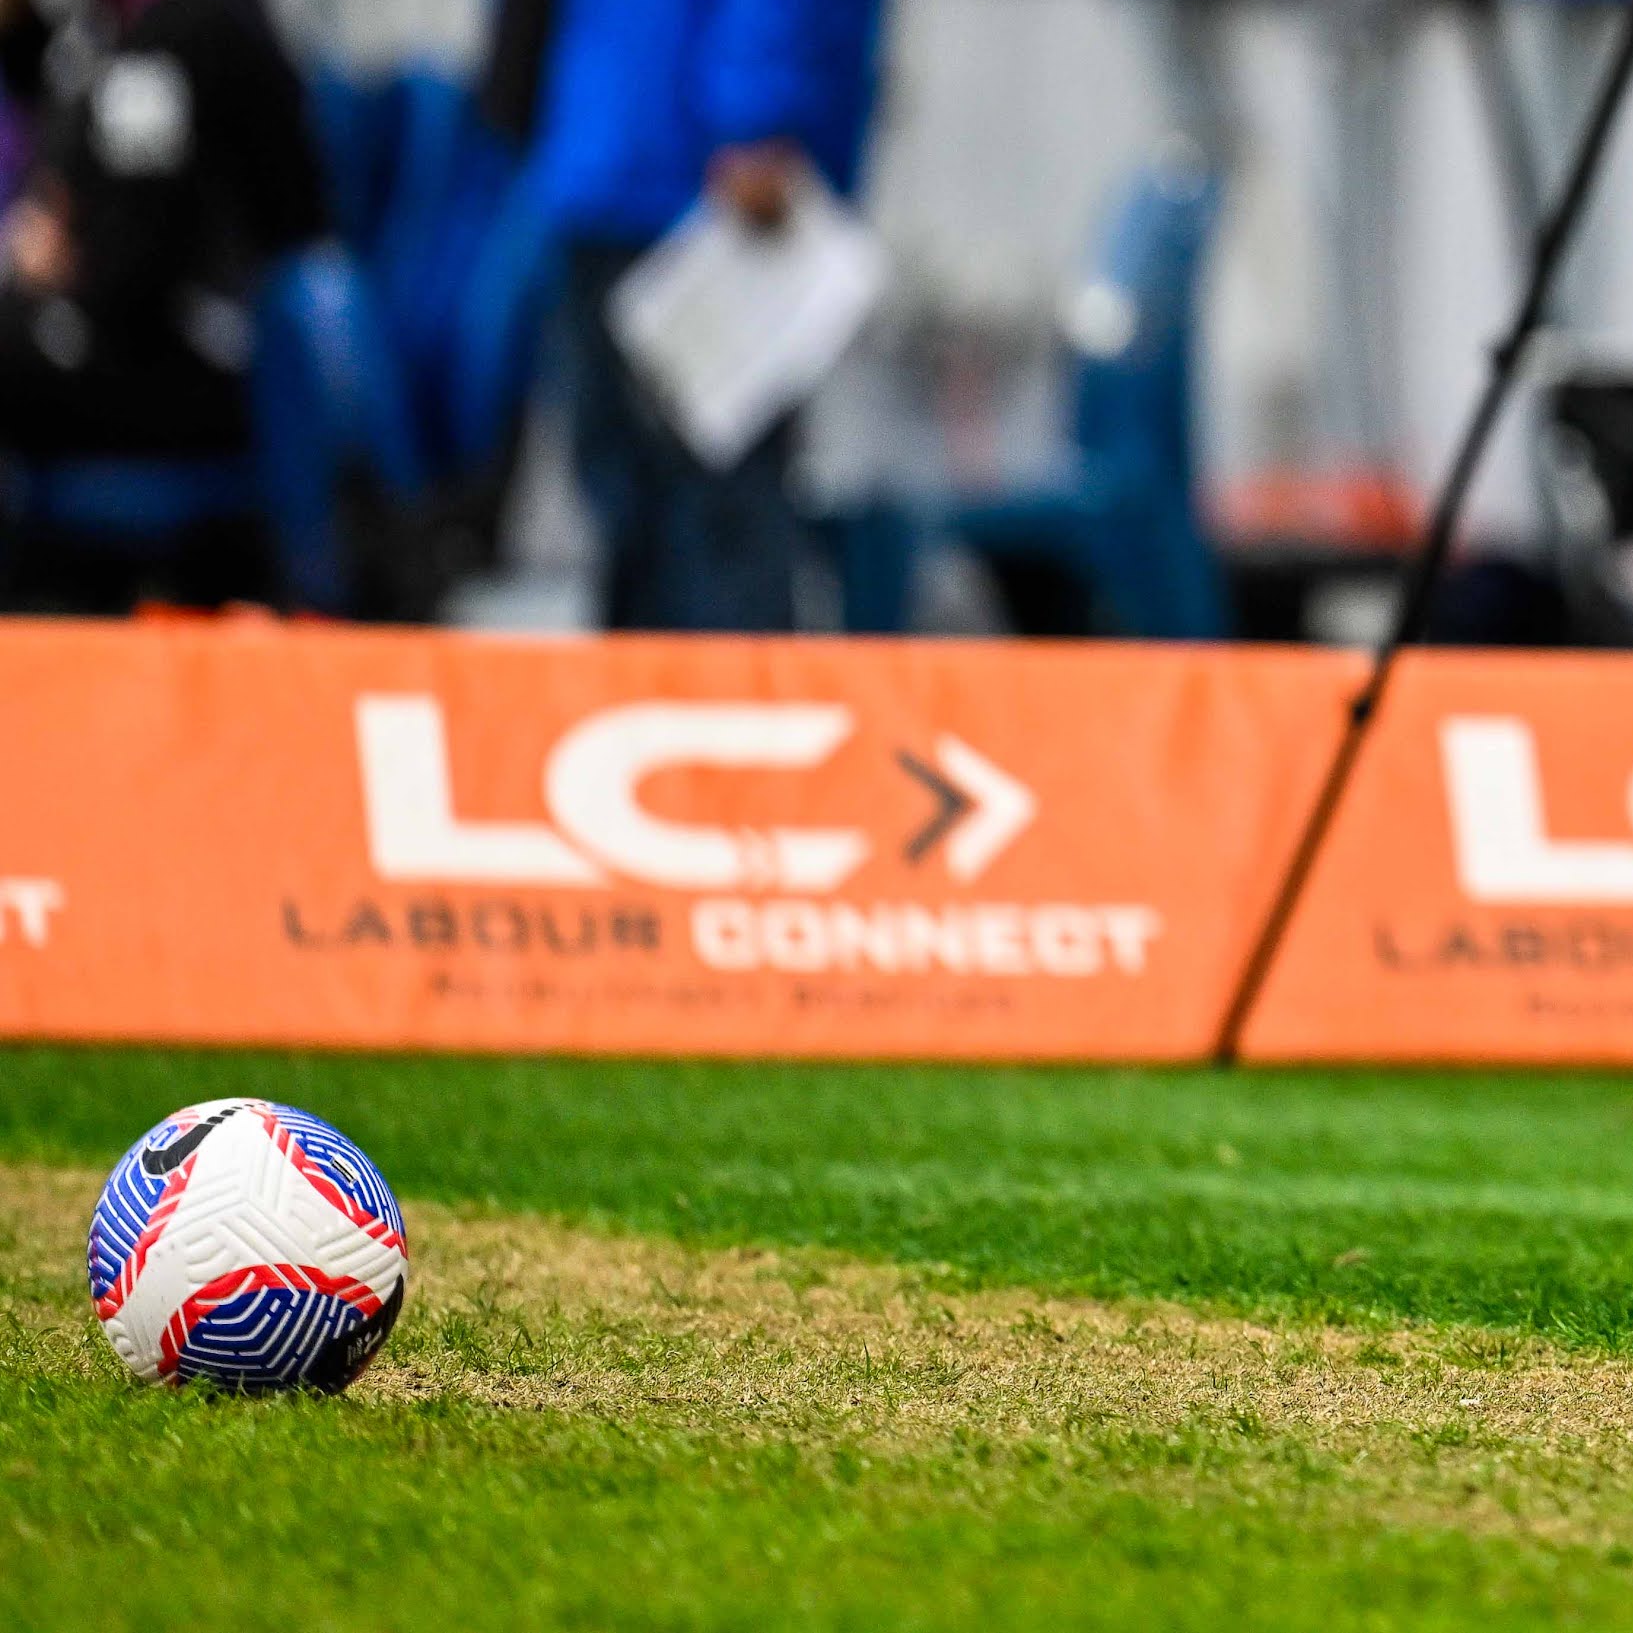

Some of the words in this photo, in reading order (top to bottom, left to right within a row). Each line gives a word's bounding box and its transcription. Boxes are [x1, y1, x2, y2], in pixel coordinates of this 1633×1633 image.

[356, 694, 868, 890] LC
[282, 898, 660, 952] LABOUR
[690, 899, 1160, 976] CONNECT
